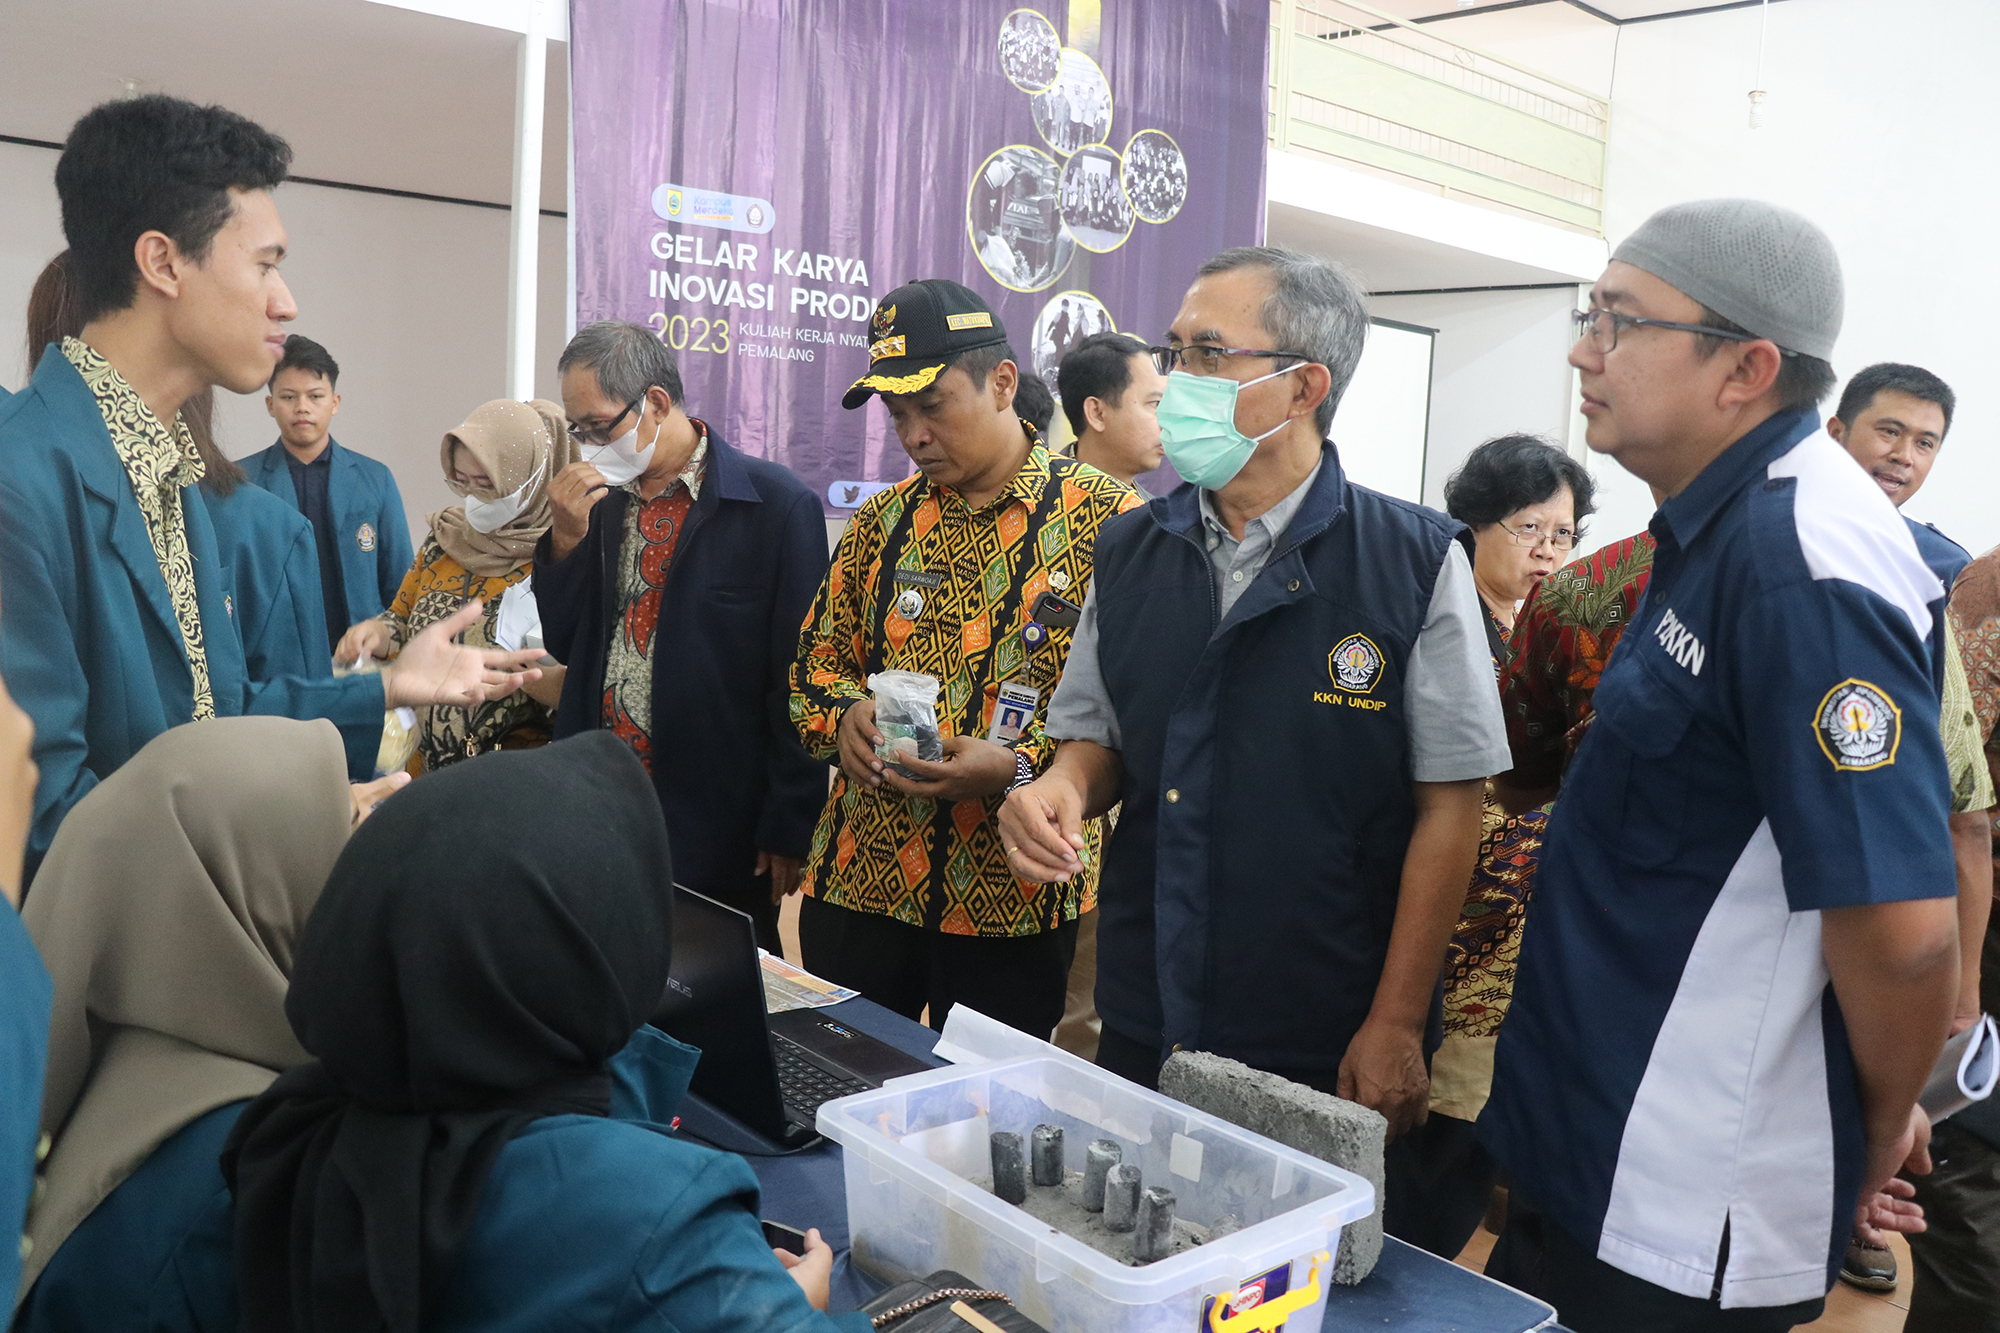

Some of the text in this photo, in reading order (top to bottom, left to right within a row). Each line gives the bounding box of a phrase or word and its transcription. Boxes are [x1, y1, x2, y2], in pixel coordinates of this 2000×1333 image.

[650, 231, 870, 287] GELAR KARYA
[649, 269, 775, 312] INOVASI
[648, 312, 731, 354] 2023
[739, 322, 870, 349] KULIAH KERJA NYAT
[738, 343, 815, 363] PEMALANG
[945, 510, 965, 519] NANAS
[944, 518, 964, 527] MADU
[957, 559, 979, 573] NANAS
[955, 568, 978, 581] MADU
[1653, 607, 1706, 677] P2KKN
[1032, 658, 1056, 674] NANAS
[1030, 668, 1052, 681] MADU
[1313, 691, 1387, 712] KKN UNDIP
[871, 841, 895, 853] NANAS
[986, 866, 1009, 875] NANAS
[986, 876, 1009, 884] MADU
[863, 899, 887, 911] NANAS
[981, 925, 1005, 934] NANAS
